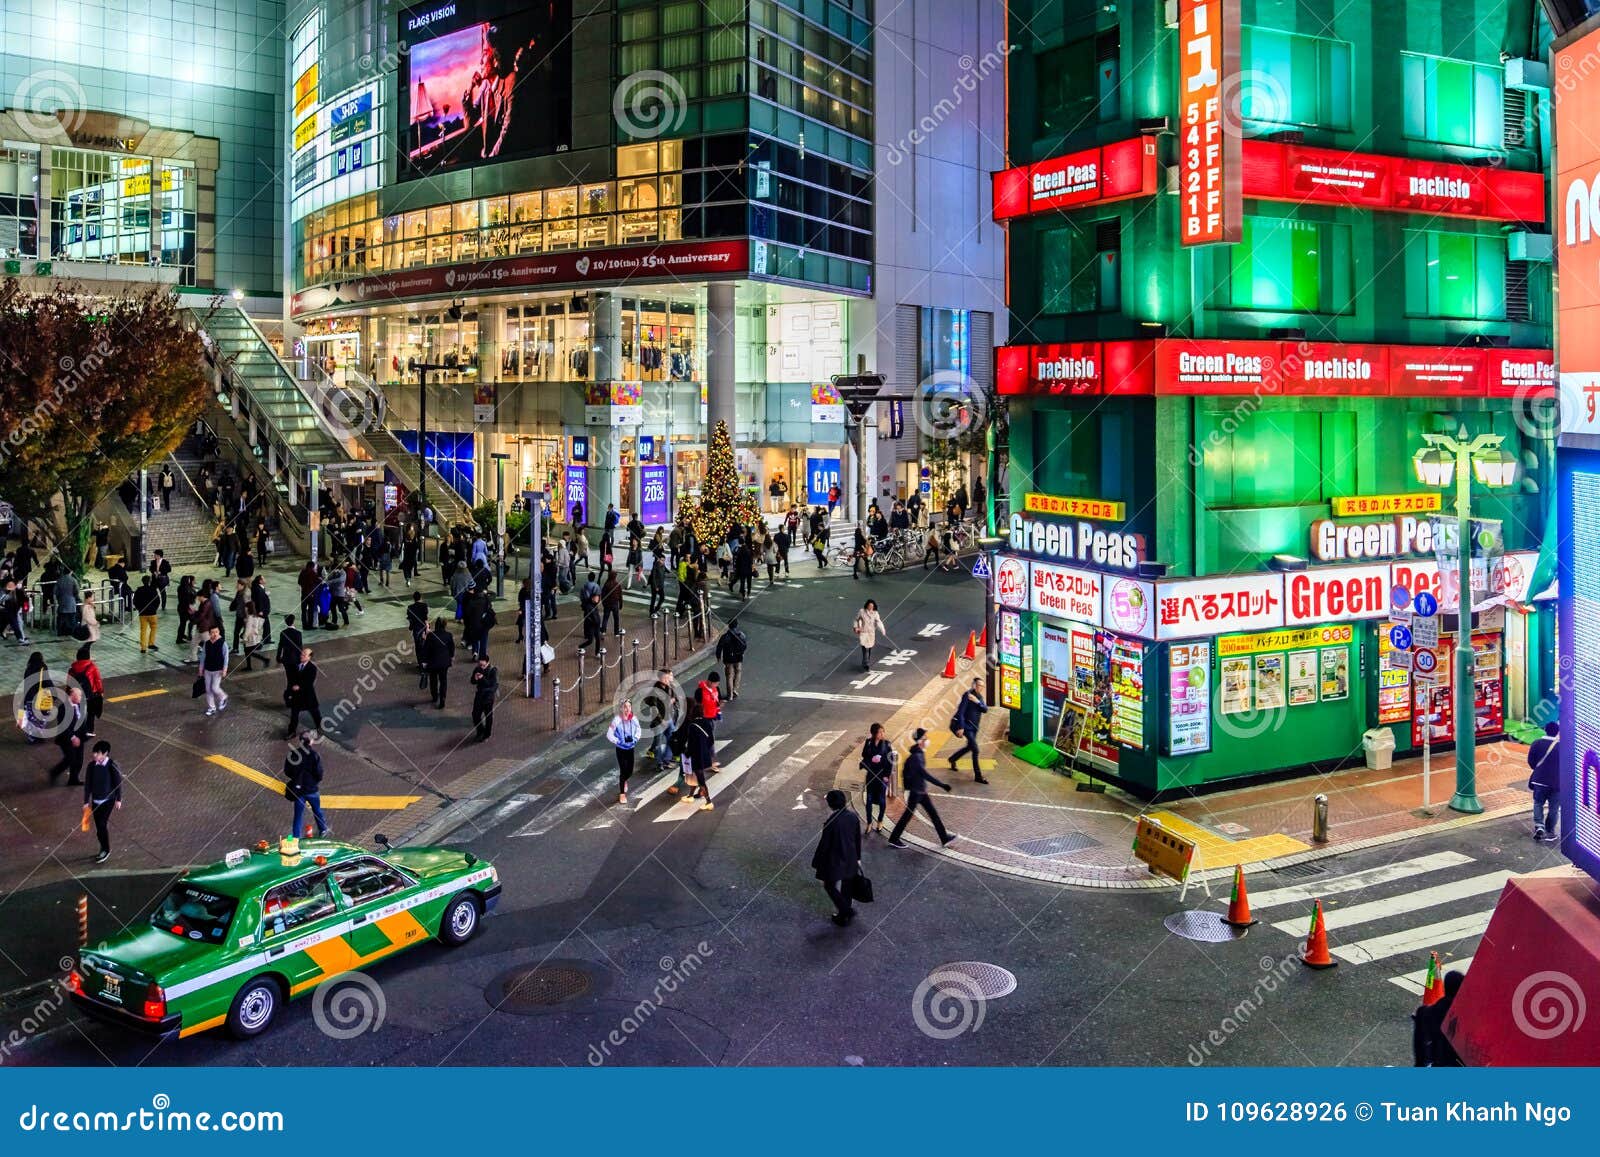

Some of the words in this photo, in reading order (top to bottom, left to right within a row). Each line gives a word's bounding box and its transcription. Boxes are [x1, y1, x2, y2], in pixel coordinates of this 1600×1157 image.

[408, 13, 430, 30] FLAGS
[431, 4, 456, 22] VISION
[1033, 170, 1066, 193] Green
[1067, 163, 1097, 185] Peas
[1408, 174, 1470, 200] pachislo
[492, 268, 510, 280] 15th
[511, 264, 557, 277] Anniversary
[593, 258, 640, 271] 10/10(thu)
[642, 255, 666, 268] 15th
[668, 252, 730, 264] Anniversary
[1038, 356, 1095, 381] pachislo
[1179, 351, 1224, 374] Green
[1225, 353, 1262, 374] Peas
[1304, 358, 1371, 380] pachislo
[1501, 359, 1535, 378] Green
[1536, 361, 1554, 379] Pea
[568, 484, 585, 501] 20%
[644, 485, 665, 501] 20%
[814, 470, 839, 493] GAP
[1009, 513, 1073, 559] Green
[1078, 521, 1138, 569] Peas
[1318, 519, 1396, 560] Green
[1400, 516, 1460, 555] Peas
[1034, 569, 1099, 598] 選べるスロット
[1040, 591, 1067, 612] Green
[1070, 597, 1093, 617] Peas
[1160, 588, 1279, 625] 選べるスロット
[1291, 574, 1383, 620] Green
[1419, 654, 1433, 667] 30
[405, 930, 417, 939] TAXI
